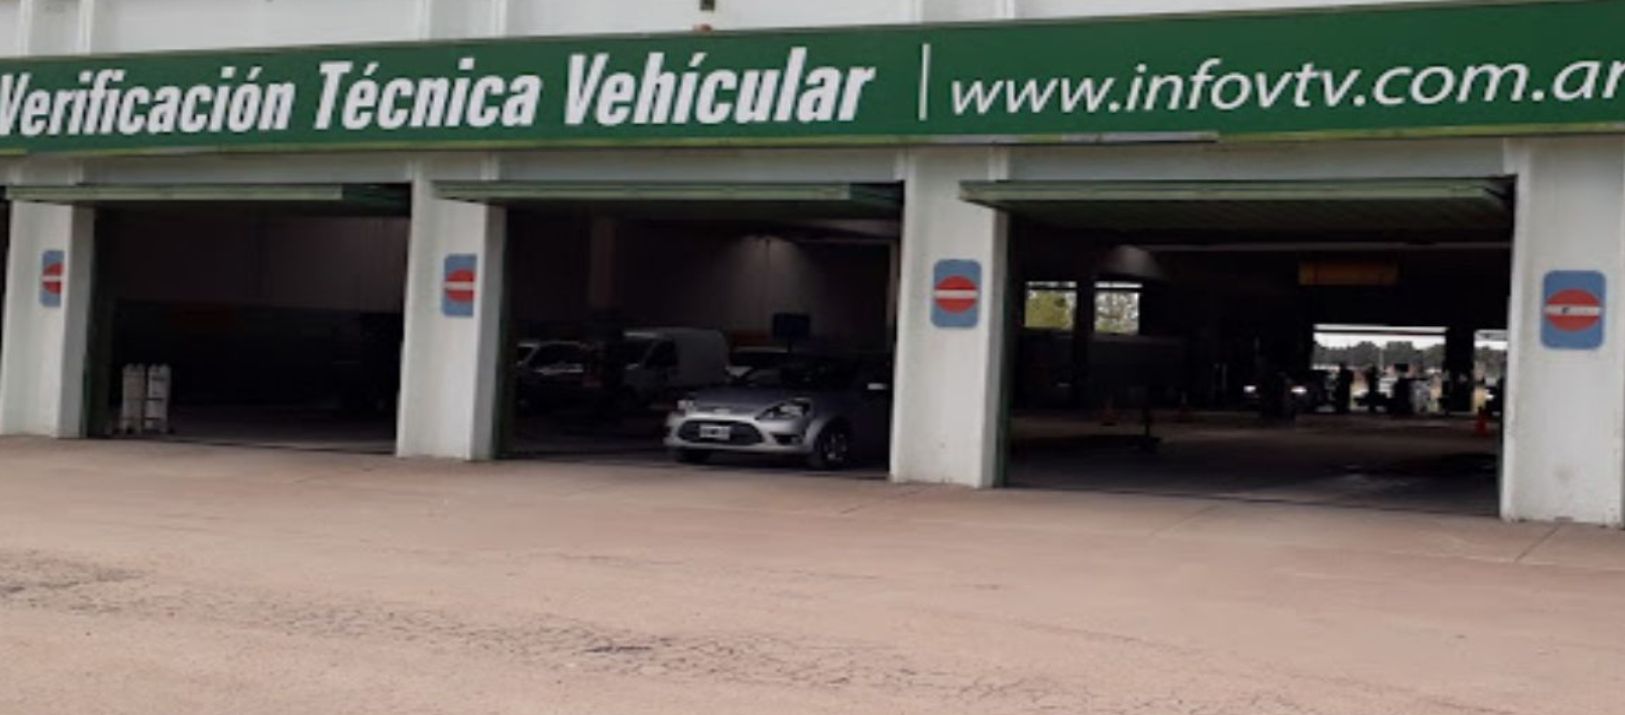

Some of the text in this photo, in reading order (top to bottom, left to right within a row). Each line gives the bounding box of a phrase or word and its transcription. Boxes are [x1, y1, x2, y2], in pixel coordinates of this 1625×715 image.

[0, 46, 877, 137] Verificación Técnica Vehícular
[950, 57, 1625, 115] www.infovtv.com.ar
